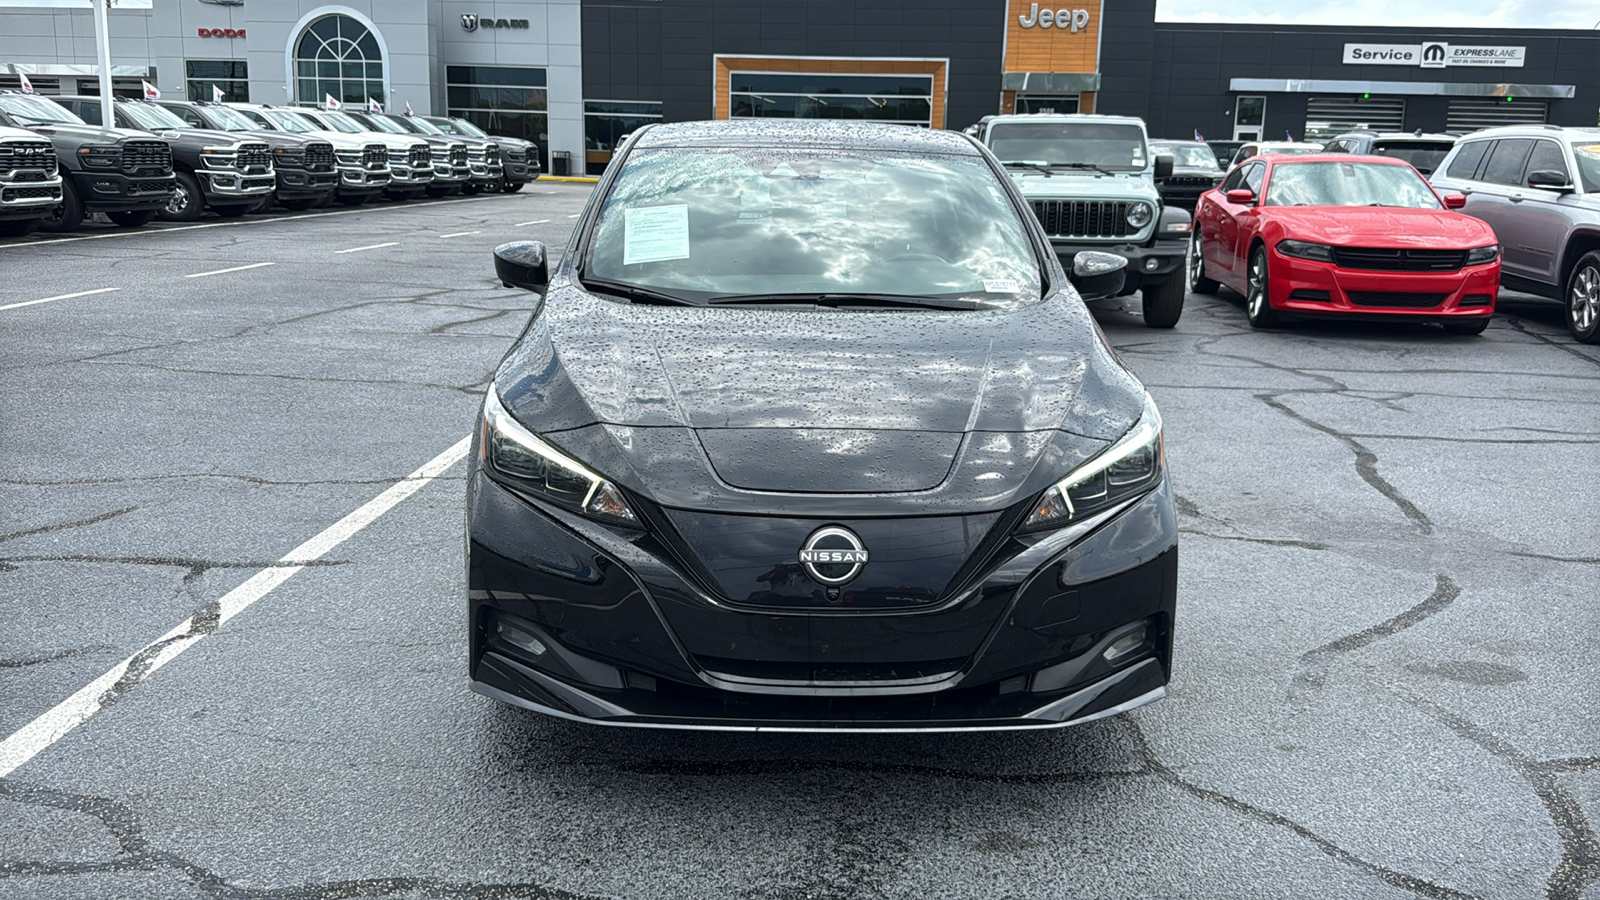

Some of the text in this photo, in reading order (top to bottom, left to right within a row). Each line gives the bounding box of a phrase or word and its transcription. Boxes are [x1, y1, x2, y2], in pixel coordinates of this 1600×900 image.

[480, 18, 529, 29] RAM
[1018, 3, 1089, 33] Jeep
[198, 28, 246, 38] DODG
[1352, 48, 1413, 60] Service
[801, 552, 866, 561] NISSAN
